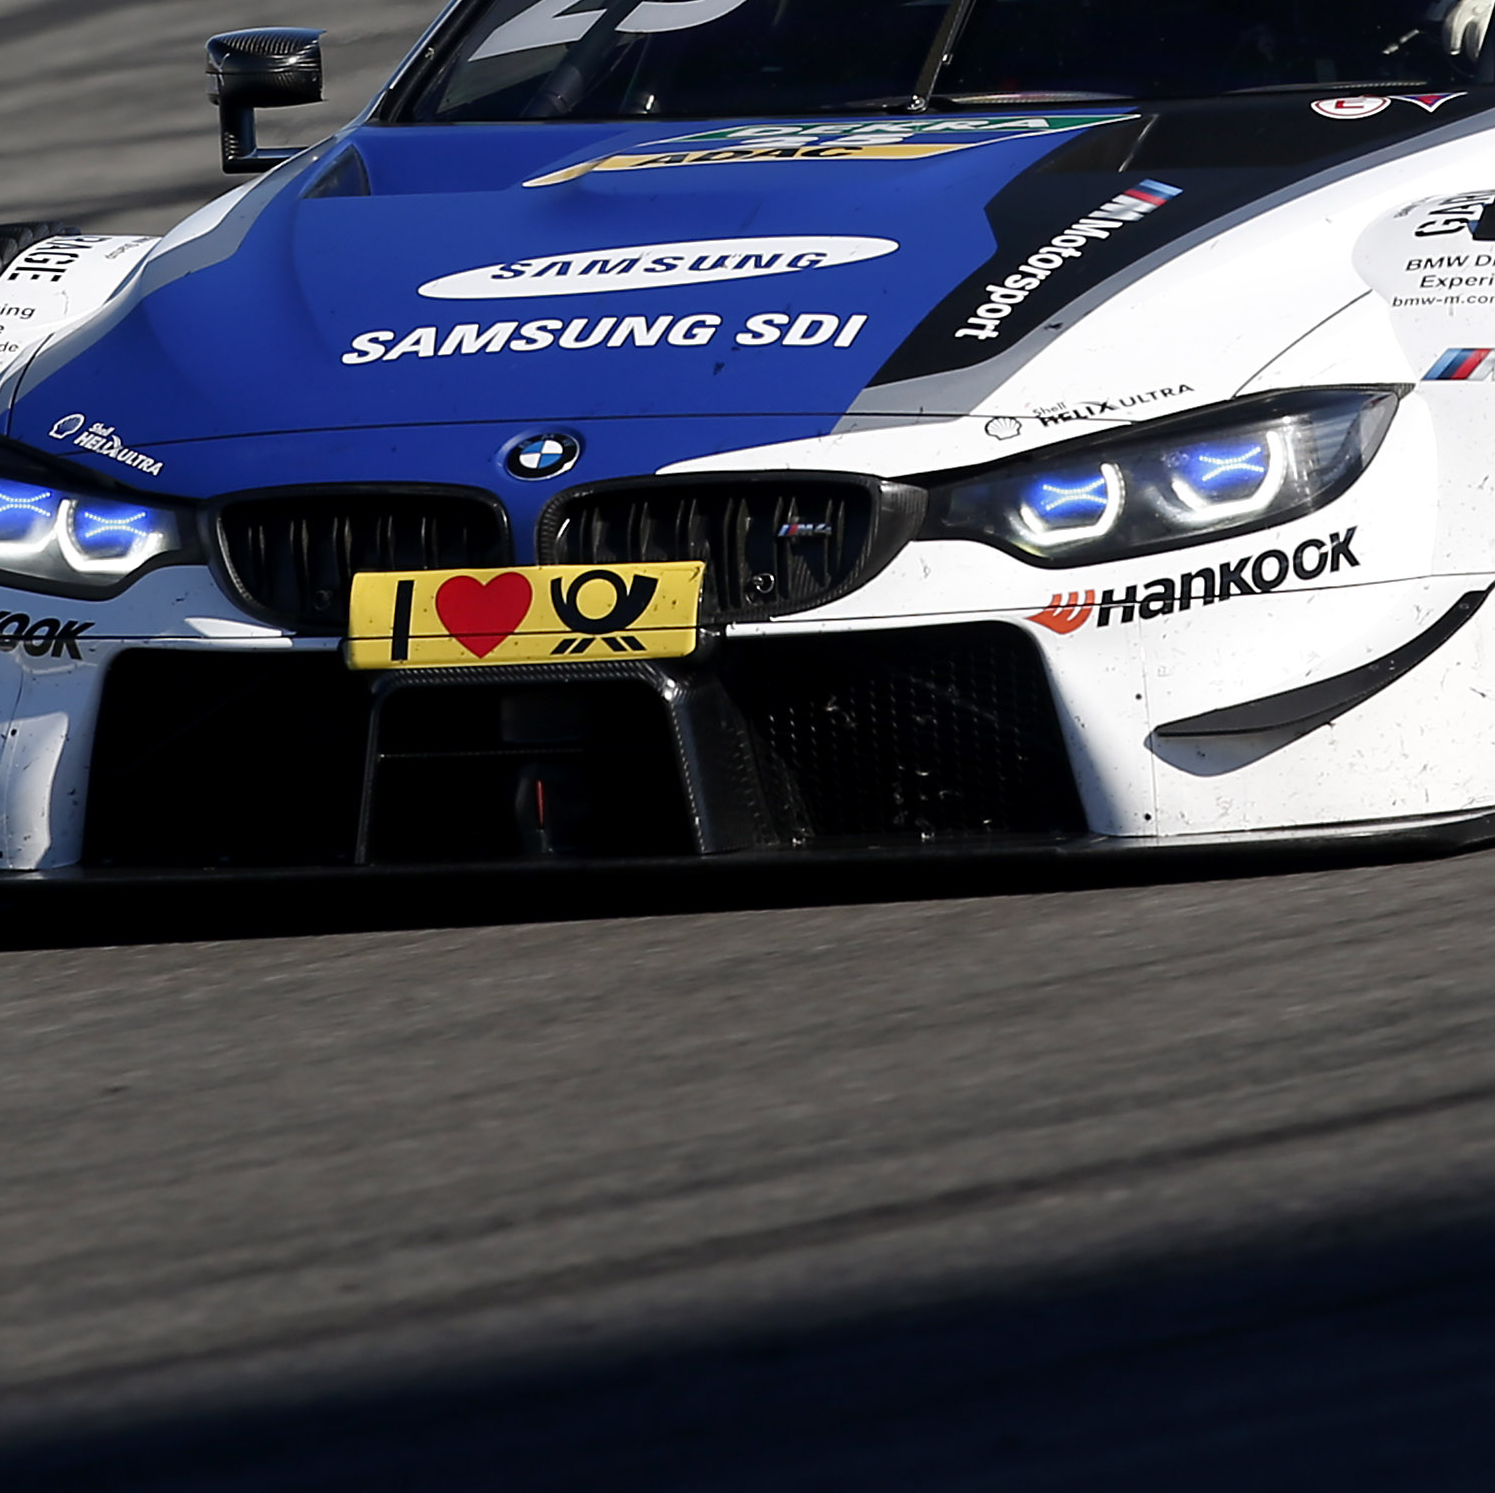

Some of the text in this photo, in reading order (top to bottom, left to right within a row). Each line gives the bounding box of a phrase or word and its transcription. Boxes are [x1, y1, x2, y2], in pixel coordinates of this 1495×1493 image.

[726, 117, 1052, 137] DEKRA
[636, 146, 864, 166] ADAC
[490, 250, 830, 281] SAMSUNG
[1405, 254, 1470, 272] BMW
[954, 218, 1124, 341] Motorsport
[341, 312, 869, 366] SAMSUNG SDI
[1032, 401, 1067, 417] Shell
[1119, 383, 1195, 409] ULTRA
[117, 448, 164, 476] ULTRA
